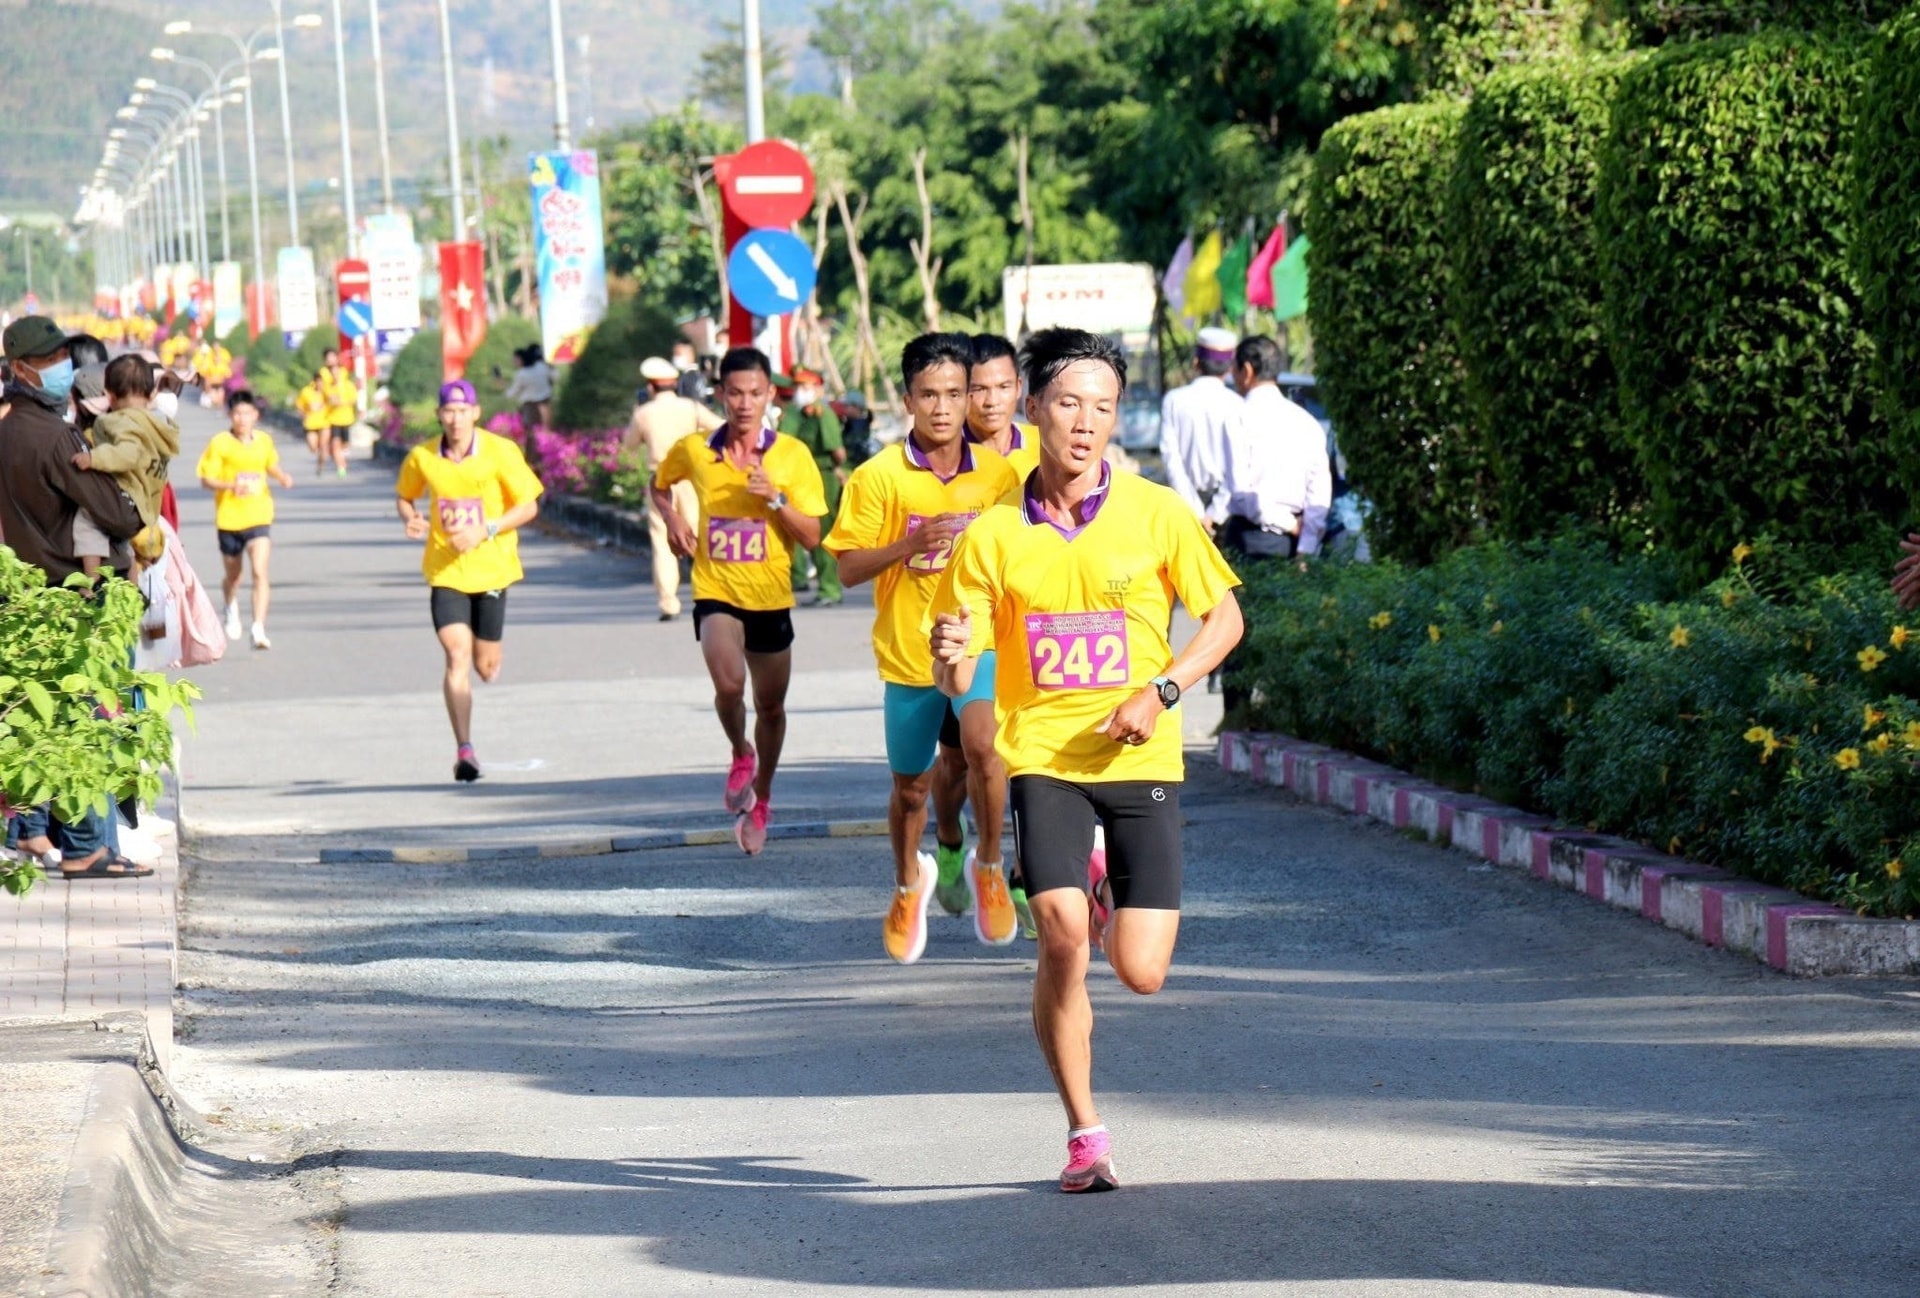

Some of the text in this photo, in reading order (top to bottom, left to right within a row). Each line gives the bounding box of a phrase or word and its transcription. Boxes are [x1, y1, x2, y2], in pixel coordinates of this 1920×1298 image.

[711, 529, 763, 560] 214
[908, 530, 963, 569] 22
[1106, 579, 1128, 591] TTC
[1035, 634, 1126, 685] 242
